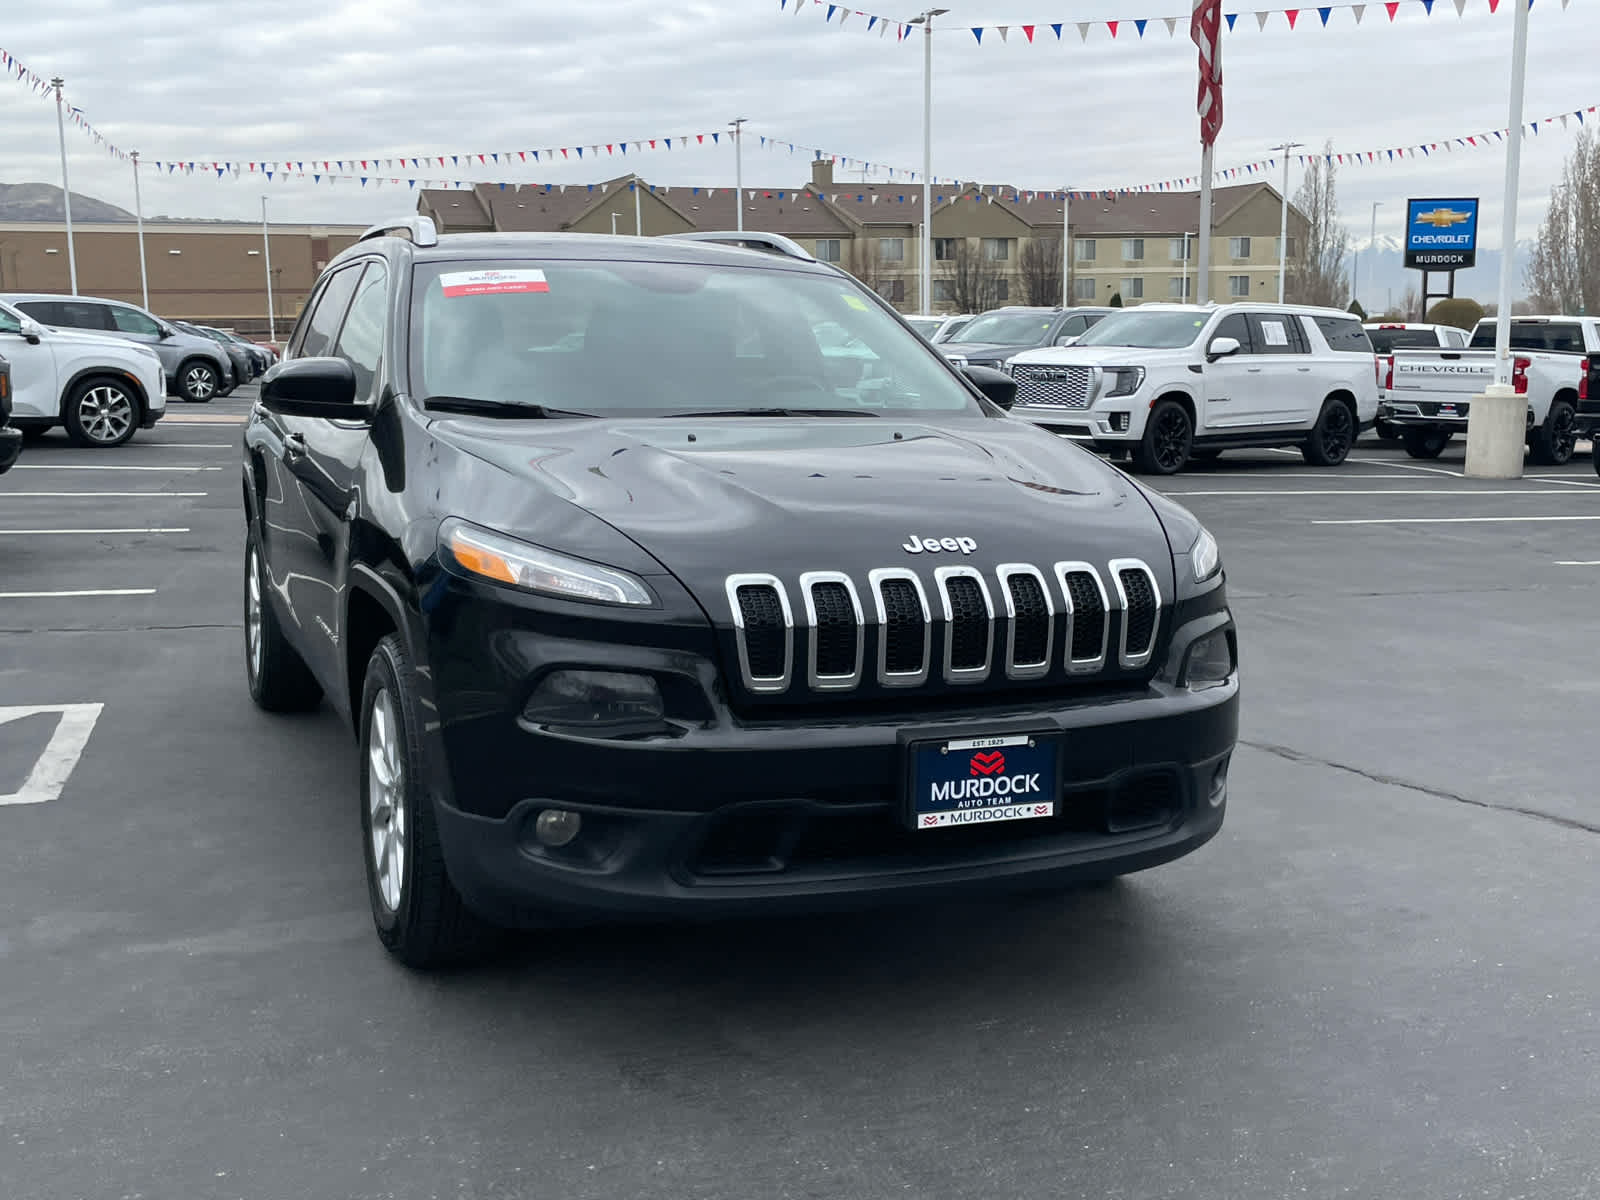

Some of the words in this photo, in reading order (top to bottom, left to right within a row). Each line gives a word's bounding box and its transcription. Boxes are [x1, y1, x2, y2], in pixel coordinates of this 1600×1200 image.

[1411, 234, 1471, 244] CHEVROLET
[1415, 255, 1464, 264] MURDOCK
[902, 535, 977, 555] Jeep
[931, 773, 1041, 802] MURDOCK
[958, 799, 983, 809] AUTO
[987, 796, 1012, 806] TEAM
[950, 806, 1023, 824] MURDOCK
